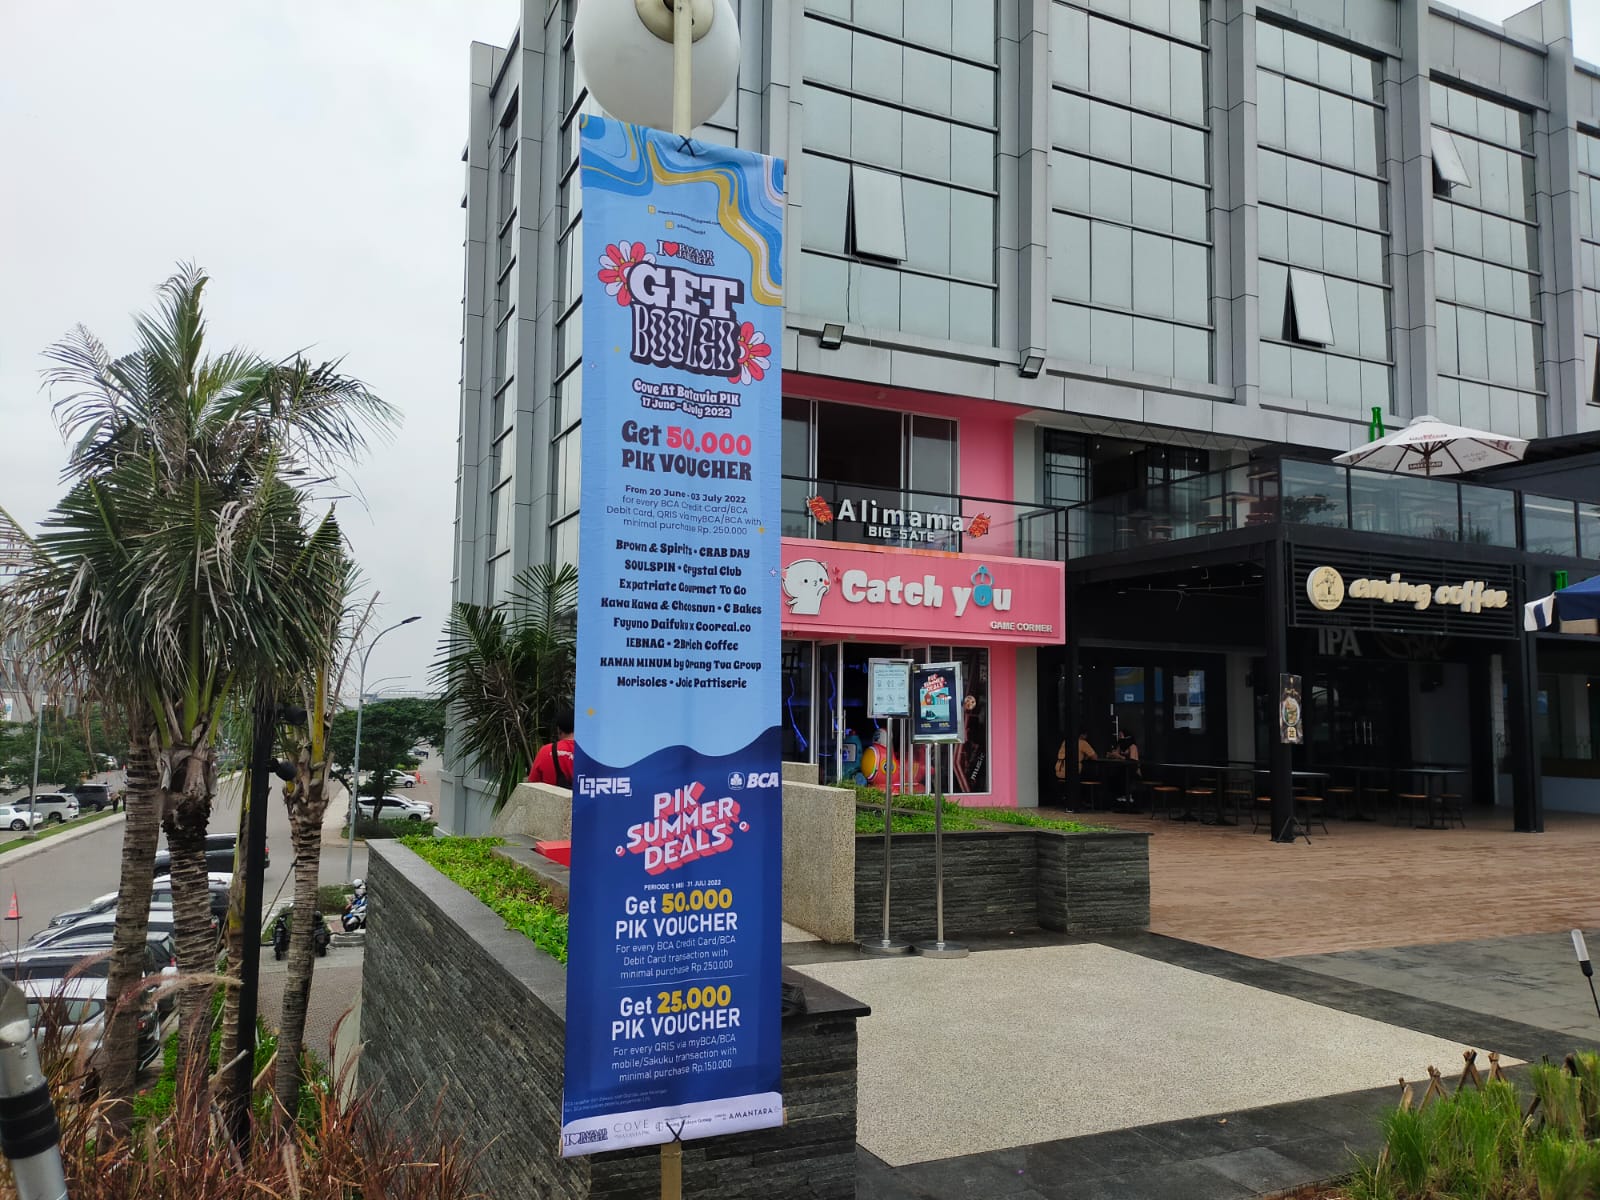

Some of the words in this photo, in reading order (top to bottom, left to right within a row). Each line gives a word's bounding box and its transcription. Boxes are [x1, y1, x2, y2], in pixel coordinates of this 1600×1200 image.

[628, 261, 742, 319] GET
[631, 304, 740, 375] BOOZED
[633, 379, 660, 396] Cove
[661, 384, 675, 397] At
[677, 385, 718, 405] Batavia
[719, 393, 741, 406] PIK
[641, 397, 651, 407] 17
[651, 398, 676, 410] June
[704, 407, 732, 418] 2022
[621, 420, 662, 447] Get
[666, 426, 752, 456] 50.000
[622, 449, 655, 472] PIK
[659, 453, 752, 481] VOUCHER
[625, 485, 647, 495] From
[649, 488, 661, 496] 20
[663, 489, 686, 498] June
[691, 492, 700, 500] 03
[702, 494, 723, 503] July
[724, 495, 747, 503] 2022
[622, 495, 634, 504] for
[636, 498, 659, 509] every
[661, 499, 679, 508] BCA
[681, 501, 702, 512] Credit
[704, 504, 748, 515] Card/BCA
[606, 505, 631, 515] Debit
[657, 510, 678, 519] QRIS
[745, 517, 762, 526] with
[837, 499, 964, 532] Alimama
[623, 518, 657, 529] minimal
[659, 522, 696, 532] purchase
[713, 526, 748, 535] 250.000
[868, 525, 891, 538] BIG
[899, 527, 935, 543] SATE
[616, 539, 647, 552] Brown
[648, 543, 658, 553] &
[660, 542, 693, 556] Spirits
[699, 547, 728, 558] CRAB
[729, 548, 750, 559] DAY
[624, 559, 676, 572] SOULSPIN
[683, 564, 718, 578] Crystal
[719, 566, 742, 576] Club
[619, 578, 677, 592] Expatriate
[678, 582, 717, 595] Gourmet
[719, 585, 731, 595] To
[733, 585, 747, 595] Go
[841, 569, 944, 608] Catch
[951, 581, 1012, 617] you
[1434, 580, 1508, 613] coffee
[600, 597, 630, 609] Kawa
[631, 599, 658, 610] Kawa
[660, 600, 670, 611] &
[723, 603, 731, 613] C
[733, 603, 762, 614] Bakes
[613, 617, 649, 630] Fuyuno
[651, 618, 689, 630] Daifuku
[990, 620, 1015, 631] GAME
[1016, 622, 1053, 633] CORNER
[704, 640, 739, 651] Coffee
[1318, 627, 1362, 657] IPA
[600, 657, 635, 667] KAWAN
[636, 658, 672, 668] MINUM
[673, 658, 685, 671] by
[685, 660, 712, 671] Orang
[713, 660, 731, 670] Tua
[733, 660, 762, 671] Group
[617, 676, 667, 688] Morisoles
[693, 677, 747, 688] Pattiserie
[577, 774, 632, 798] QRIS
[746, 772, 779, 788] BCA
[653, 781, 700, 818] PIK
[626, 797, 736, 849] SUMMER
[644, 823, 729, 871] DEALS
[643, 883, 670, 891] PERIODE
[625, 895, 657, 916] Get
[661, 888, 733, 914] 50.000
[615, 919, 648, 940] PIK
[653, 912, 738, 937] VOUCHER
[616, 944, 630, 953] For
[632, 943, 655, 954] every
[657, 940, 674, 950] BCA
[676, 939, 695, 950] Credit
[697, 935, 736, 946] Card/BCA
[623, 956, 645, 966] Debit
[647, 954, 666, 964] Card
[668, 950, 710, 963] transaction
[711, 948, 728, 958] with
[620, 967, 654, 979] minimal
[655, 965, 690, 979] purchase
[620, 996, 652, 1017] Get
[657, 984, 731, 1014] 25.000
[611, 1017, 645, 1041] PIK
[651, 1007, 741, 1037] VOUCHER
[613, 1047, 628, 1056] For
[630, 1045, 653, 1056] every
[654, 1042, 675, 1051] QRIS
[676, 1040, 687, 1049] via
[688, 1033, 736, 1048] myBCA/BCA
[611, 1055, 674, 1070] mobile/Sakuku
[675, 1049, 718, 1063] transaction
[720, 1046, 737, 1056] with
[619, 1069, 652, 1082] minimal
[653, 1067, 690, 1080] purchase
[728, 1108, 773, 1120] AMANTARA
[613, 1119, 649, 1133] COVE
